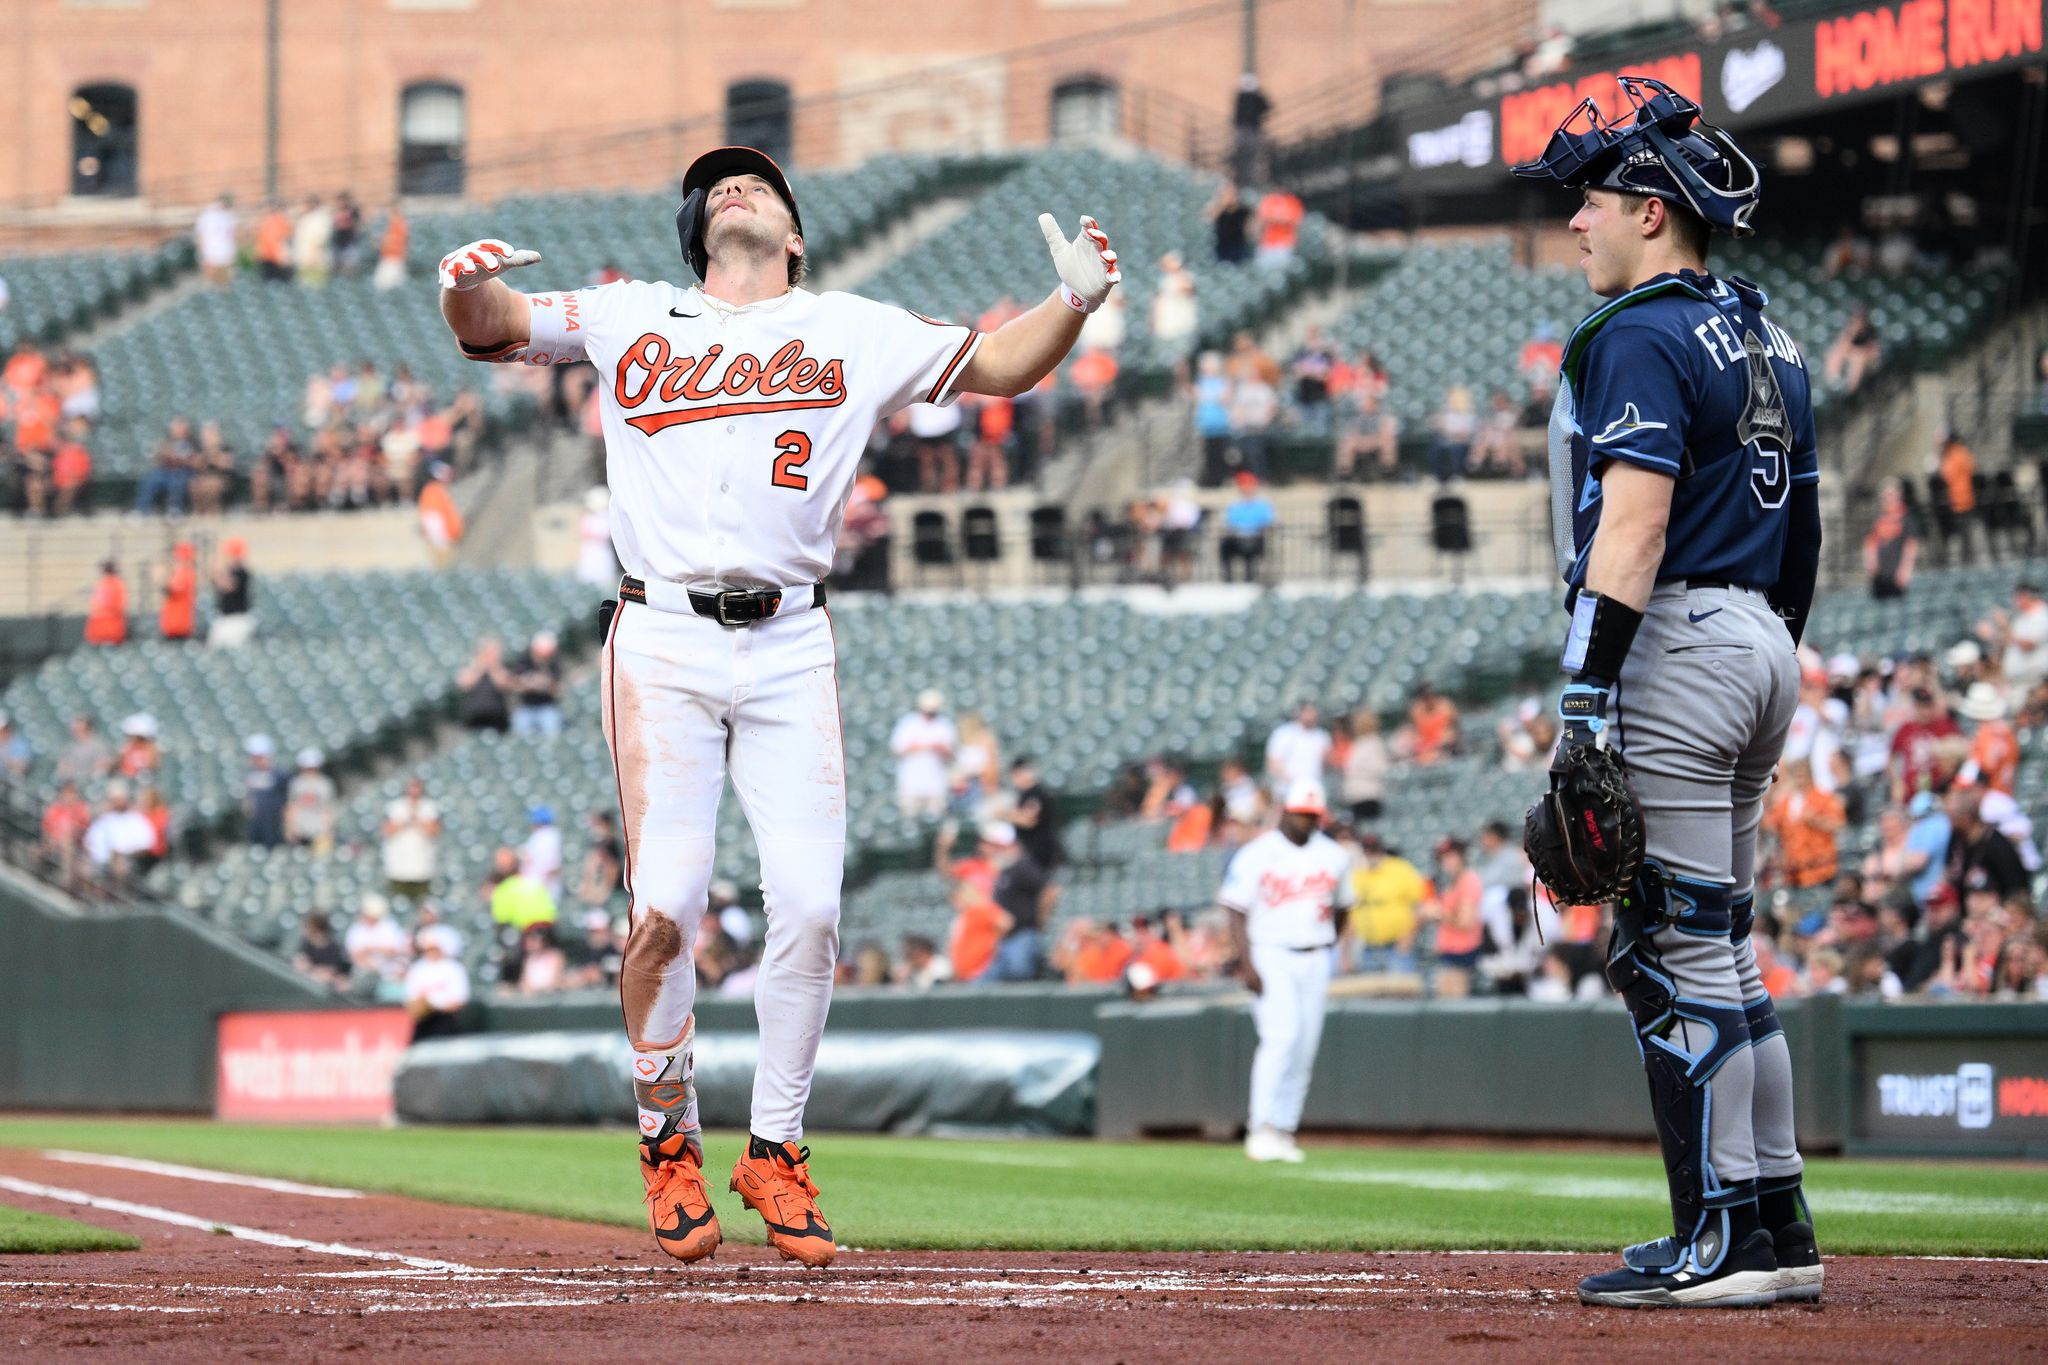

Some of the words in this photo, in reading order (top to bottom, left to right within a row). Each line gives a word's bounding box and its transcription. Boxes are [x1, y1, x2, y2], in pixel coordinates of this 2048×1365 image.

[1814, 3, 1947, 98] HOME
[1949, 0, 2042, 68] RUN
[532, 297, 553, 308] 2
[615, 333, 847, 410] Orioles
[771, 429, 812, 491] 2
[1877, 1073, 1957, 1117] TRUST
